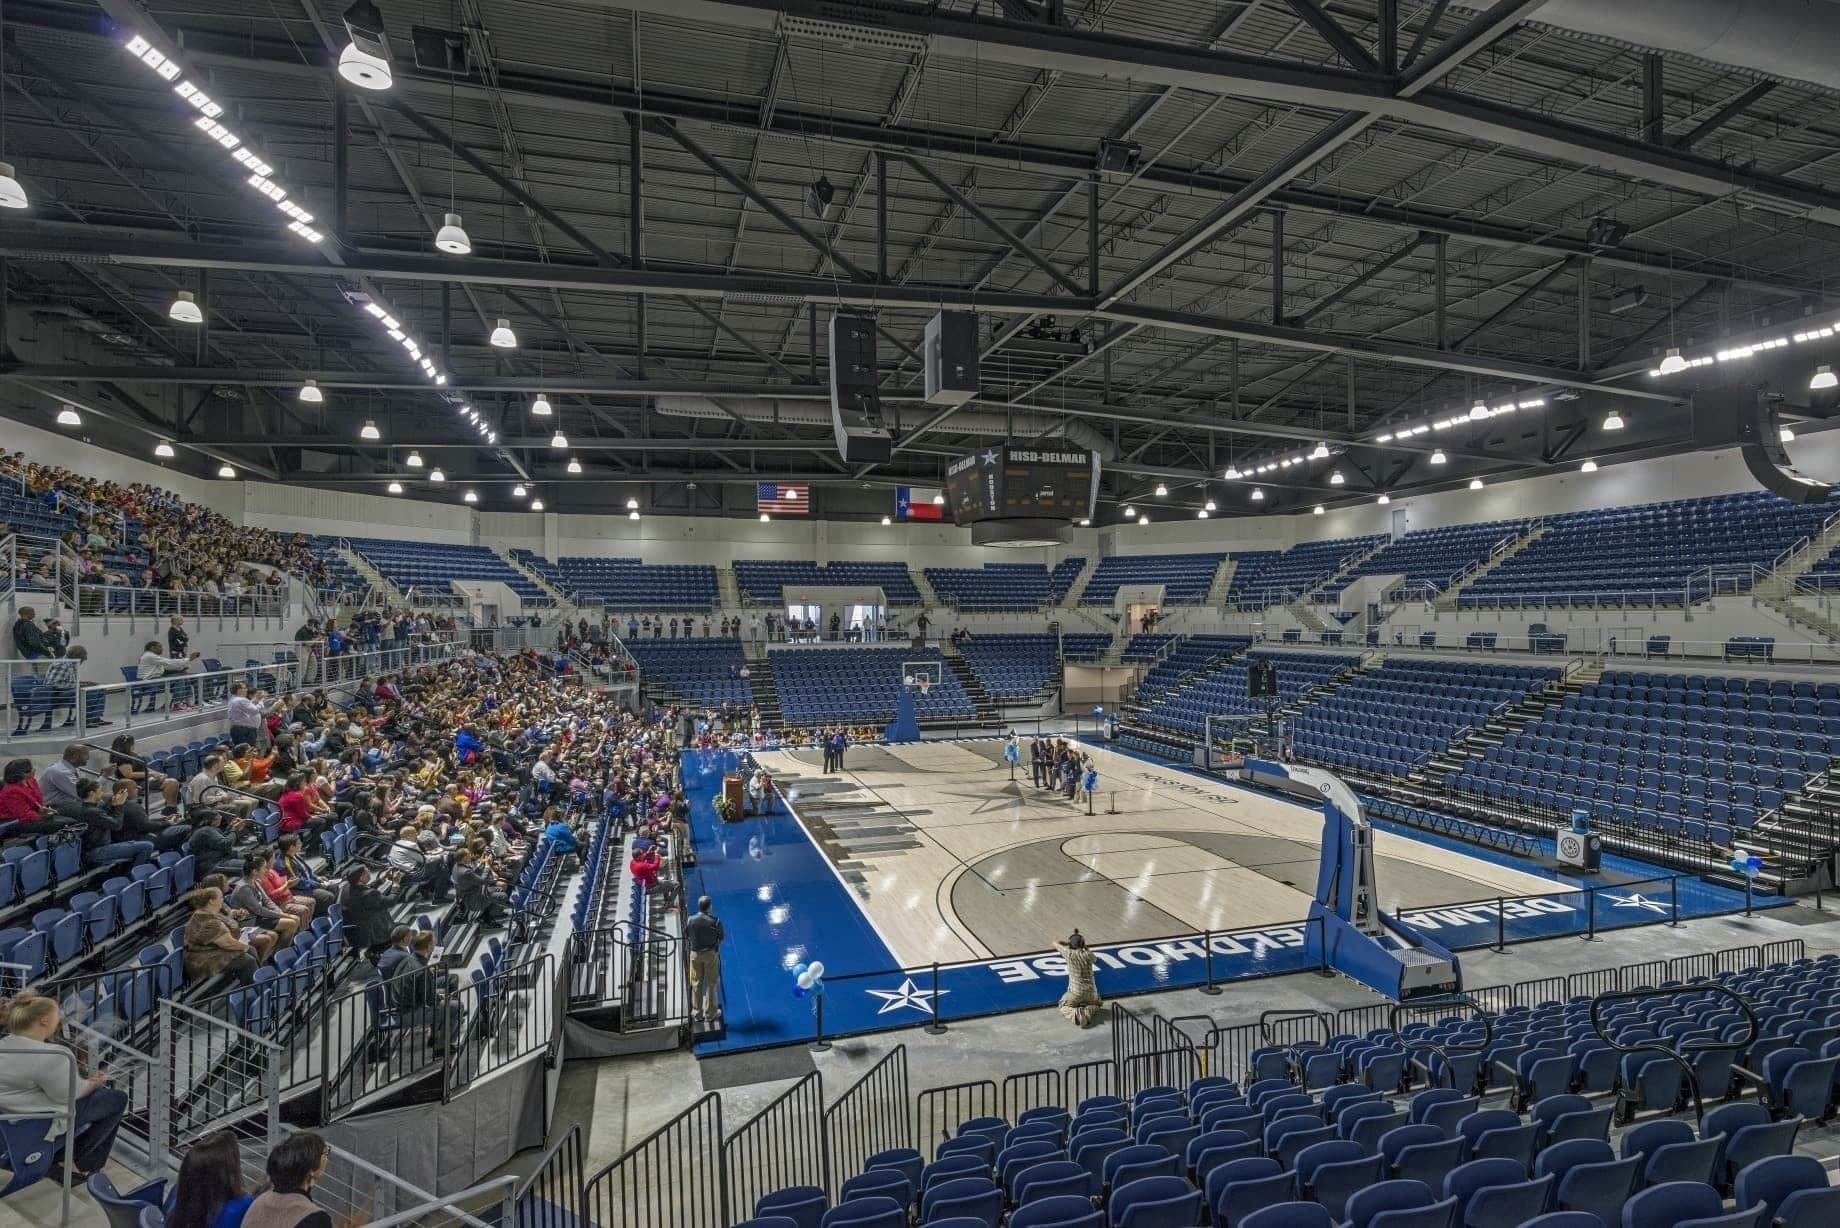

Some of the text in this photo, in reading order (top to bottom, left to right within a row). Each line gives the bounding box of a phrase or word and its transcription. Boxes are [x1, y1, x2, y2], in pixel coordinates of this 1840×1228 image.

[1009, 450, 1087, 464] HISD-DELMAR
[989, 898, 1577, 984] DELMA ELDHOUSE
